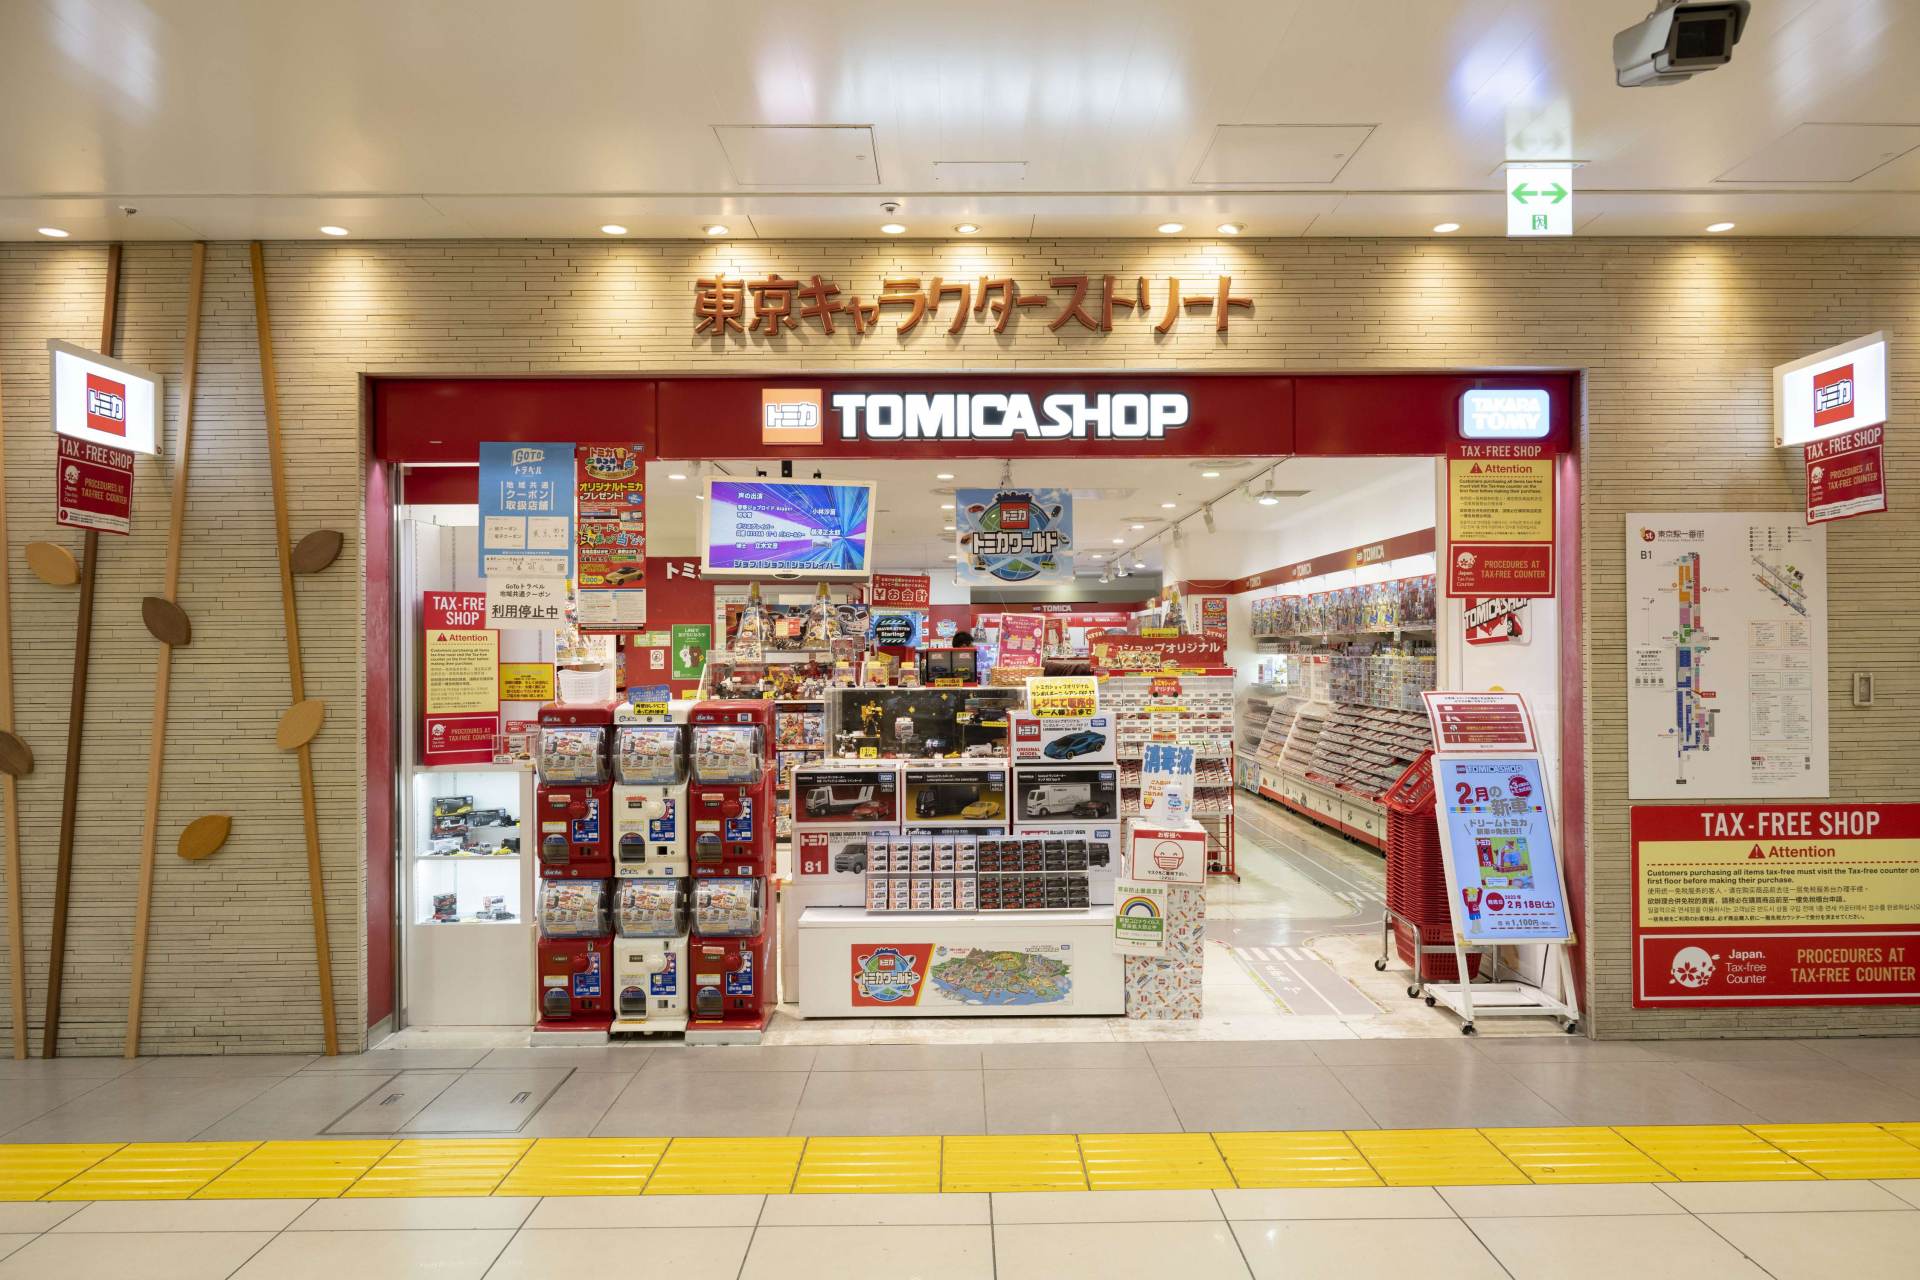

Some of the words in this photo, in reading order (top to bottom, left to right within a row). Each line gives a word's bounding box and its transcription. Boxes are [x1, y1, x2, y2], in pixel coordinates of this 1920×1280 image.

[694, 274, 1254, 336] 東京キャラクターストリート
[1815, 378, 1853, 414] トミカ
[88, 388, 125, 422] トミカ
[1472, 397, 1541, 412] TAKARA
[765, 403, 820, 429] トミカ
[832, 392, 1190, 439] TOMICASHOP
[1472, 412, 1541, 431] TOMY
[1807, 436, 1851, 460] TAX-FREE
[1853, 427, 1881, 446] SHOP
[60, 438, 108, 466] TAX-FREE
[108, 455, 132, 470] SHOP
[1461, 446, 1511, 457] TAX-FREE
[1513, 445, 1541, 456] SHOP
[514, 466, 542, 475] トラベル
[1485, 464, 1532, 475] Attention
[579, 482, 644, 491] オリジナルトミカ
[506, 490, 549, 500] クーポン
[1002, 510, 1027, 521] トミカ
[973, 530, 1058, 554] トミカワールド
[1363, 544, 1385, 561] TOMICA
[1640, 550, 1652, 560] B1
[665, 561, 701, 579] トミ
[1484, 560, 1529, 570] PROCEDURES
[1530, 560, 1541, 569] AT
[1481, 570, 1511, 579] TAX-FREE
[1513, 569, 1546, 579] COUNTER
[888, 588, 928, 602] お会計
[432, 596, 486, 611] TAX-FRE
[492, 604, 558, 619] 利用停止中
[446, 611, 480, 626] SHOP
[449, 634, 488, 642] Attention
[1018, 725, 1039, 735] トミカ
[1466, 765, 1522, 773] TOMICASHOP
[1469, 819, 1528, 827] ドリームトミカ
[1700, 812, 1812, 837] TAX-FREE
[1819, 811, 1881, 836] SHOP
[801, 834, 827, 847] トミカ
[1768, 845, 1835, 858] Attention
[804, 861, 822, 873] 81
[1647, 869, 1688, 877] Customers
[1689, 869, 1732, 877] purchasing
[1743, 868, 1764, 876] items
[1709, 877, 1737, 885] making
[1757, 877, 1794, 885] purchase.
[1728, 949, 1766, 960] Japan.
[1797, 948, 1882, 964] PROCEDURES
[1888, 948, 1905, 962] AT
[1725, 962, 1767, 973] Tax-free
[862, 972, 913, 986] トミカワールド
[1726, 973, 1766, 984] Counter
[1790, 968, 1850, 983] TAX-FREE
[1856, 967, 1915, 982] COUNTER
